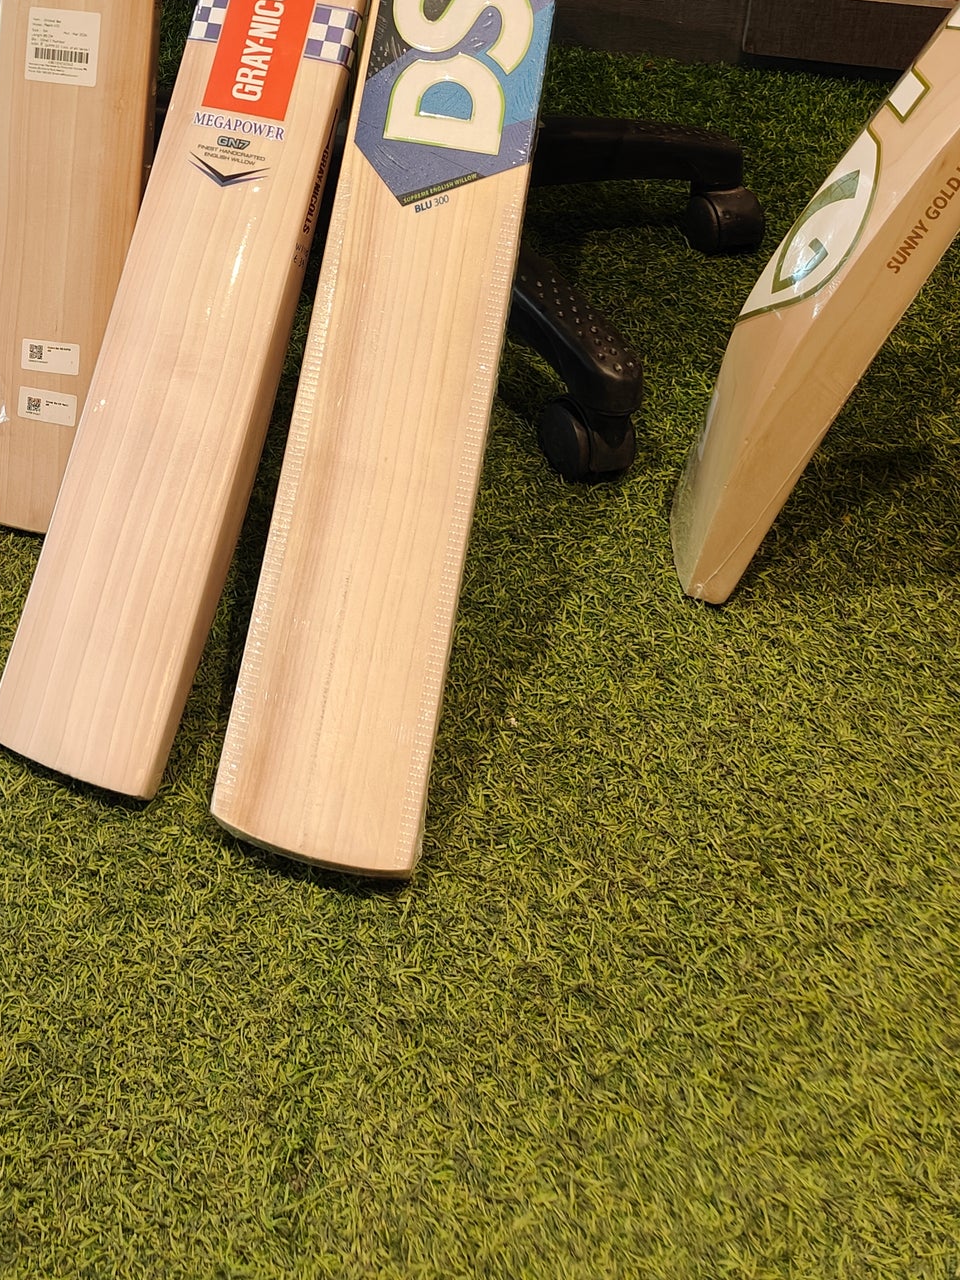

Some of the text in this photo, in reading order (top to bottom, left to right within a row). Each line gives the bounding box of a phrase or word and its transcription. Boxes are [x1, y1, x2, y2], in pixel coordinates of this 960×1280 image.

[193, 111, 285, 141] MEGAPOWER
[197, 143, 266, 162] FINEST HANDCRAFTED
[216, 135, 251, 150] GN7
[203, 151, 256, 166] ENGLISH WILLOW
[403, 173, 477, 204] SUPREME ENGLISH WILLOW
[414, 194, 450, 214] BLU 300
[886, 176, 960, 274] SUNNY GOLD
